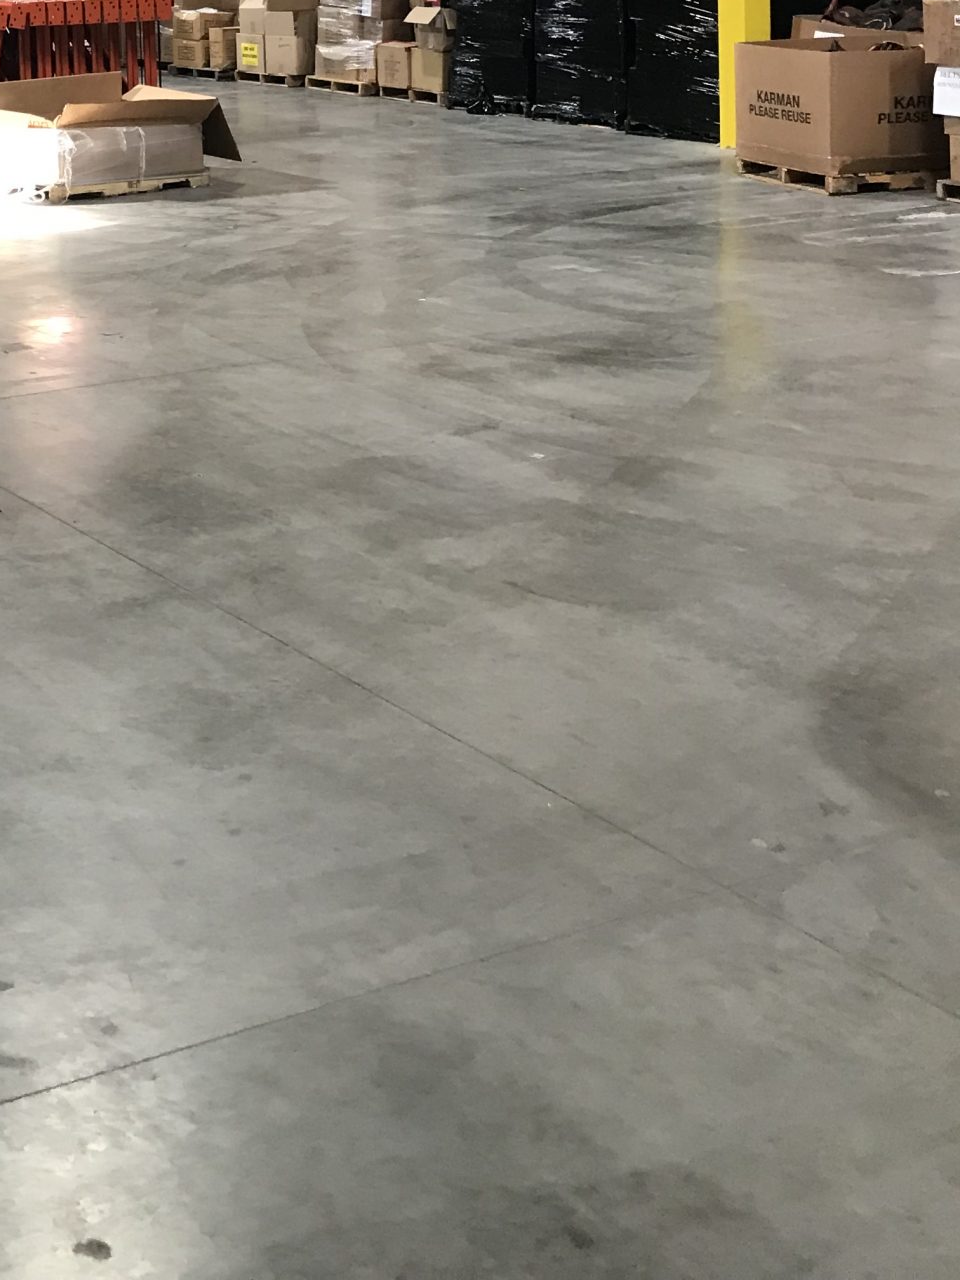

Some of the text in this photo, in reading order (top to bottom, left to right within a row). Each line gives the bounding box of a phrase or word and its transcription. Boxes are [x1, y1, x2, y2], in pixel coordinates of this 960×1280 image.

[757, 89, 800, 109] KARMAN
[749, 103, 811, 124] PLEASE REUSE
[877, 110, 930, 124] PLEASE
